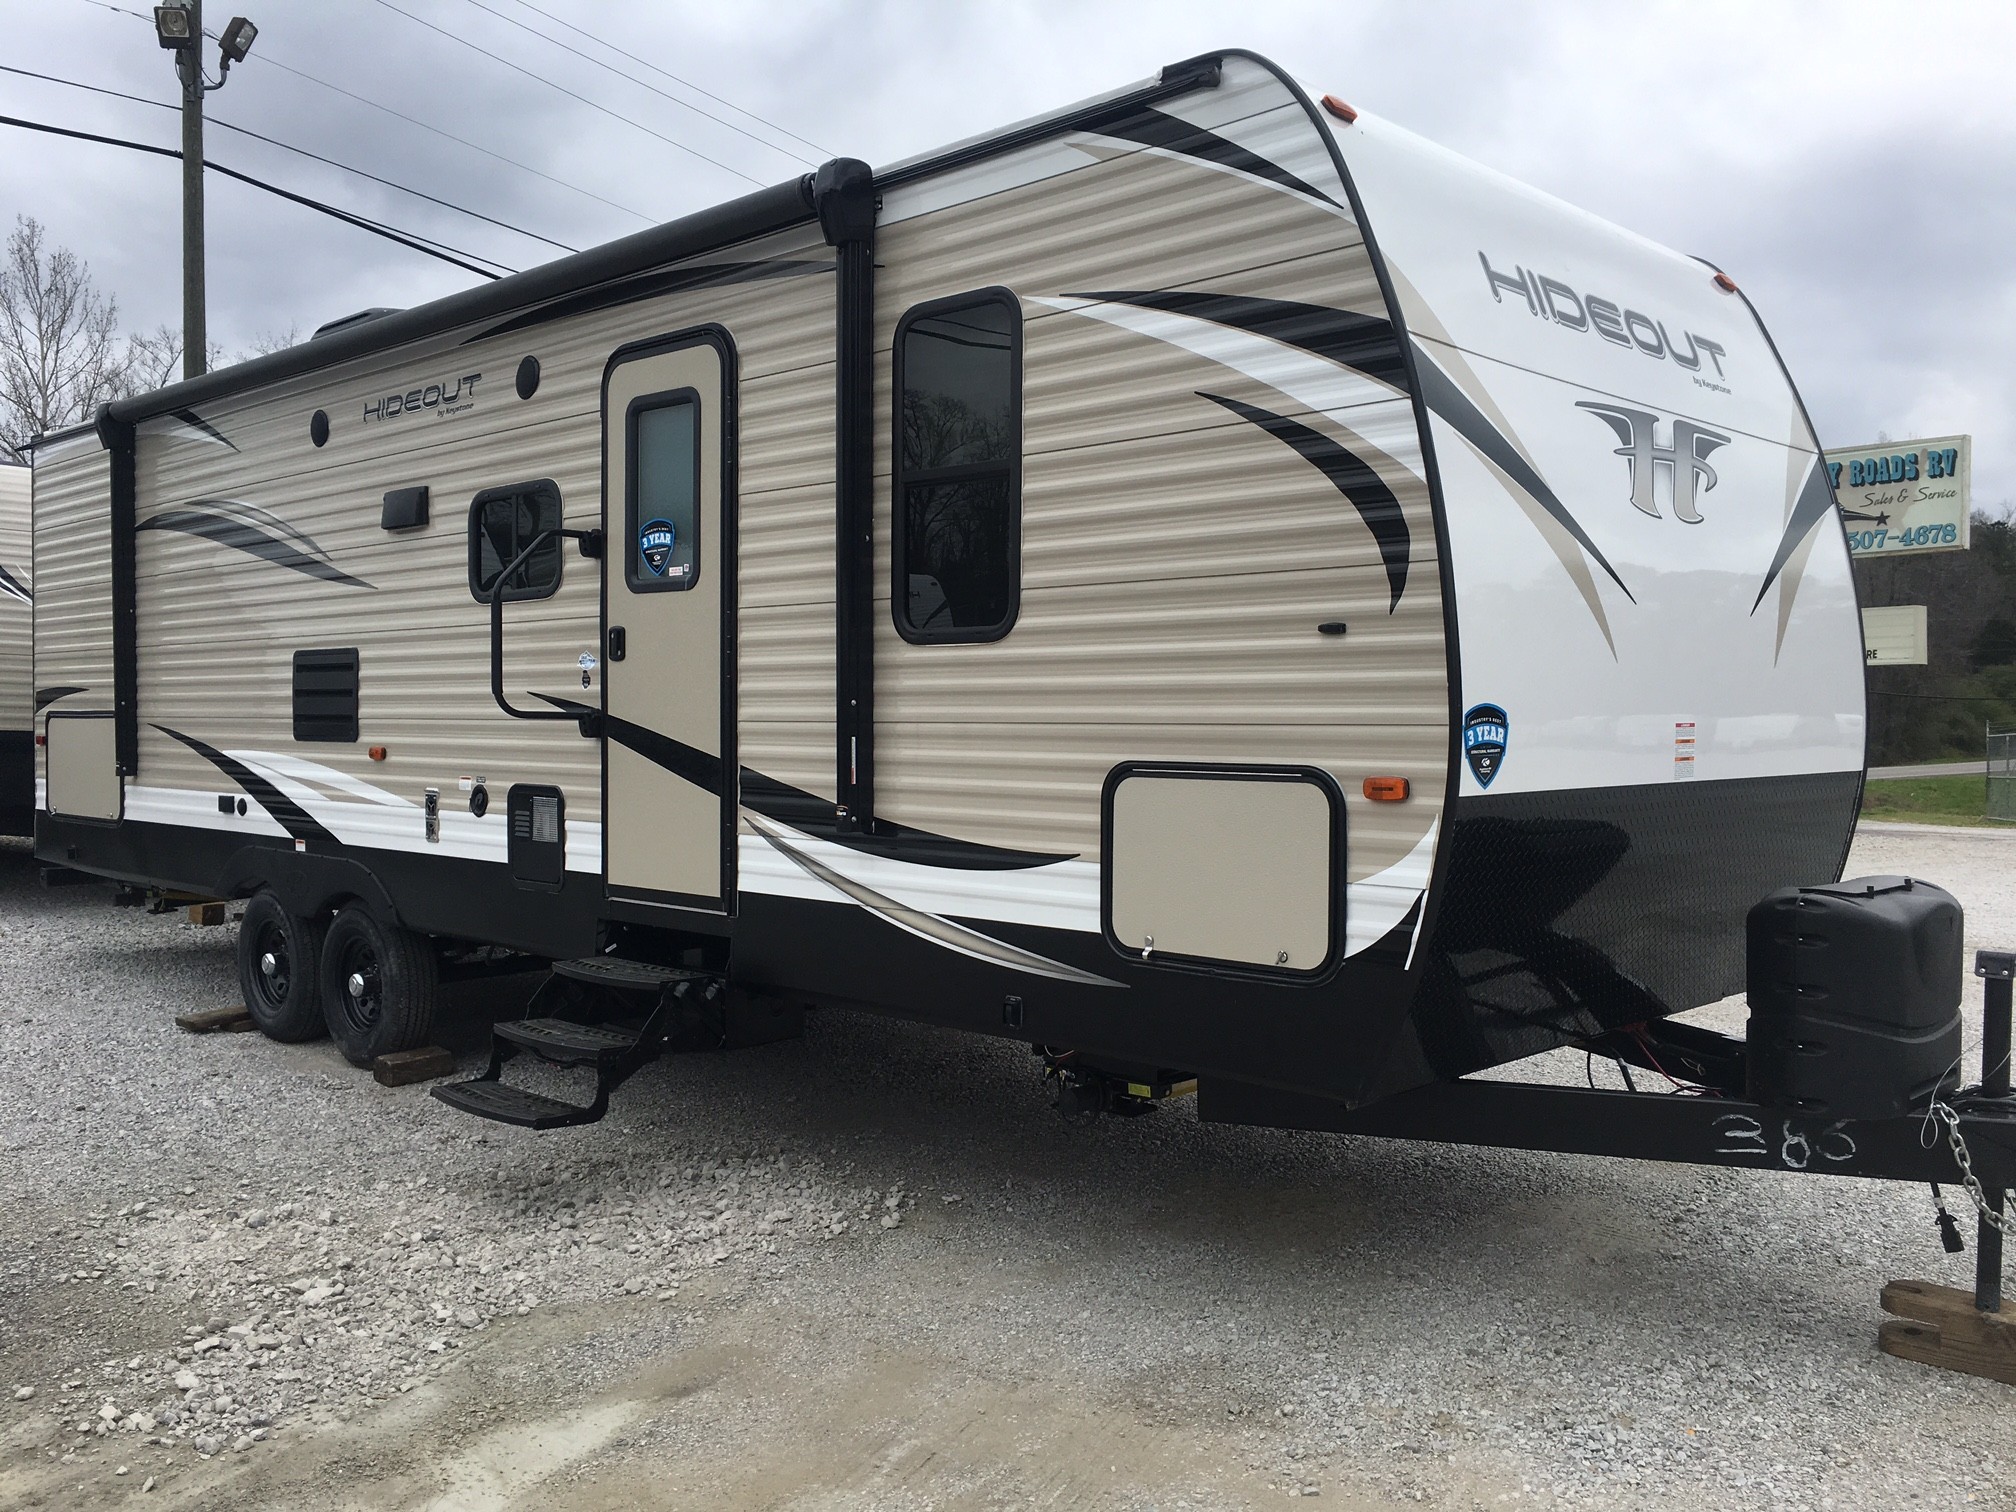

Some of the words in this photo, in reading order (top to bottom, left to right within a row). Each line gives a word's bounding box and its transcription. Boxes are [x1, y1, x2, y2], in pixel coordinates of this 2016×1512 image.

[1478, 250, 1726, 381] HIDEOUT
[363, 373, 482, 424] HIDEOUT
[446, 402, 474, 415] Keystone
[1849, 453, 1919, 487] ROADS
[1926, 448, 1958, 479] RV
[1859, 492, 1894, 508] Sales
[1896, 488, 1909, 503] &
[1912, 486, 1958, 503] Service
[642, 537, 648, 549] 3
[649, 533, 671, 544] YEAR
[1848, 523, 1957, 550] 507-4678
[1467, 730, 1475, 746] 3
[1477, 726, 1504, 743] YEAR
